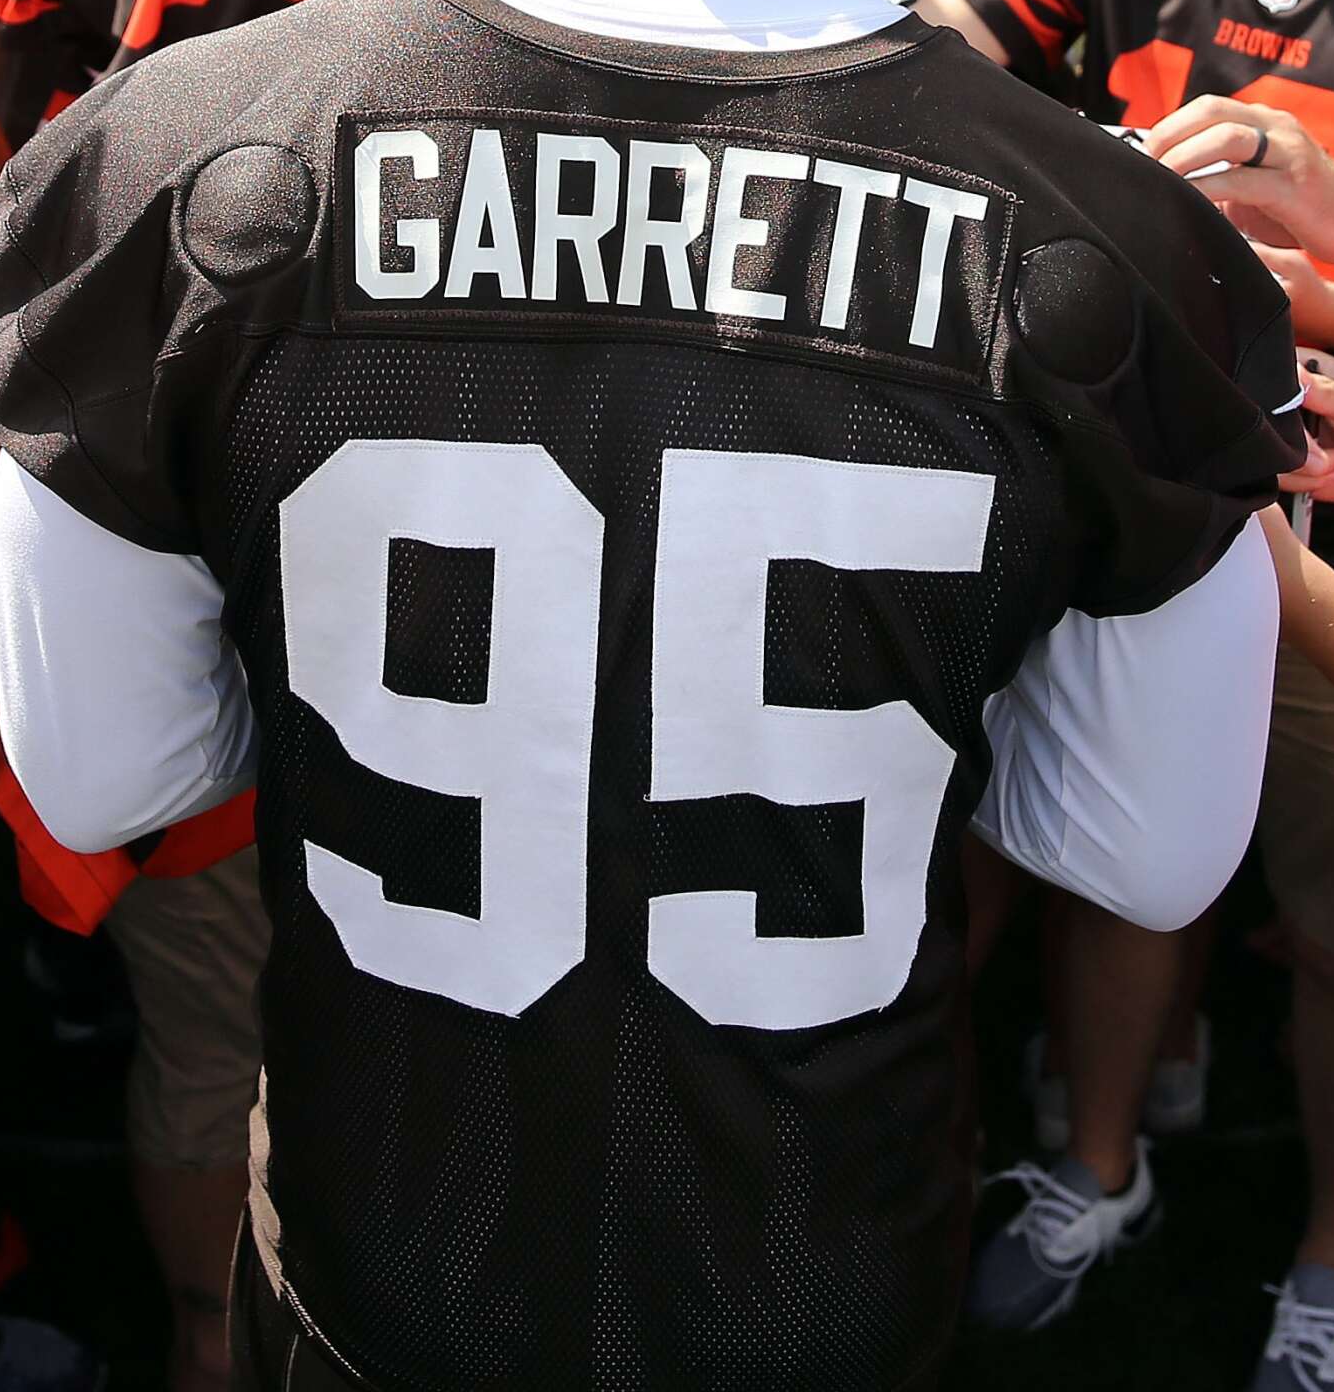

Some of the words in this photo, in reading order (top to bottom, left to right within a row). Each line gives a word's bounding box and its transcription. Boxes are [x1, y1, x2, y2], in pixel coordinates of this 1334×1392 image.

[1213, 17, 1313, 69] BROWNS
[354, 128, 989, 349] GARRETT
[277, 438, 998, 1032] 95
